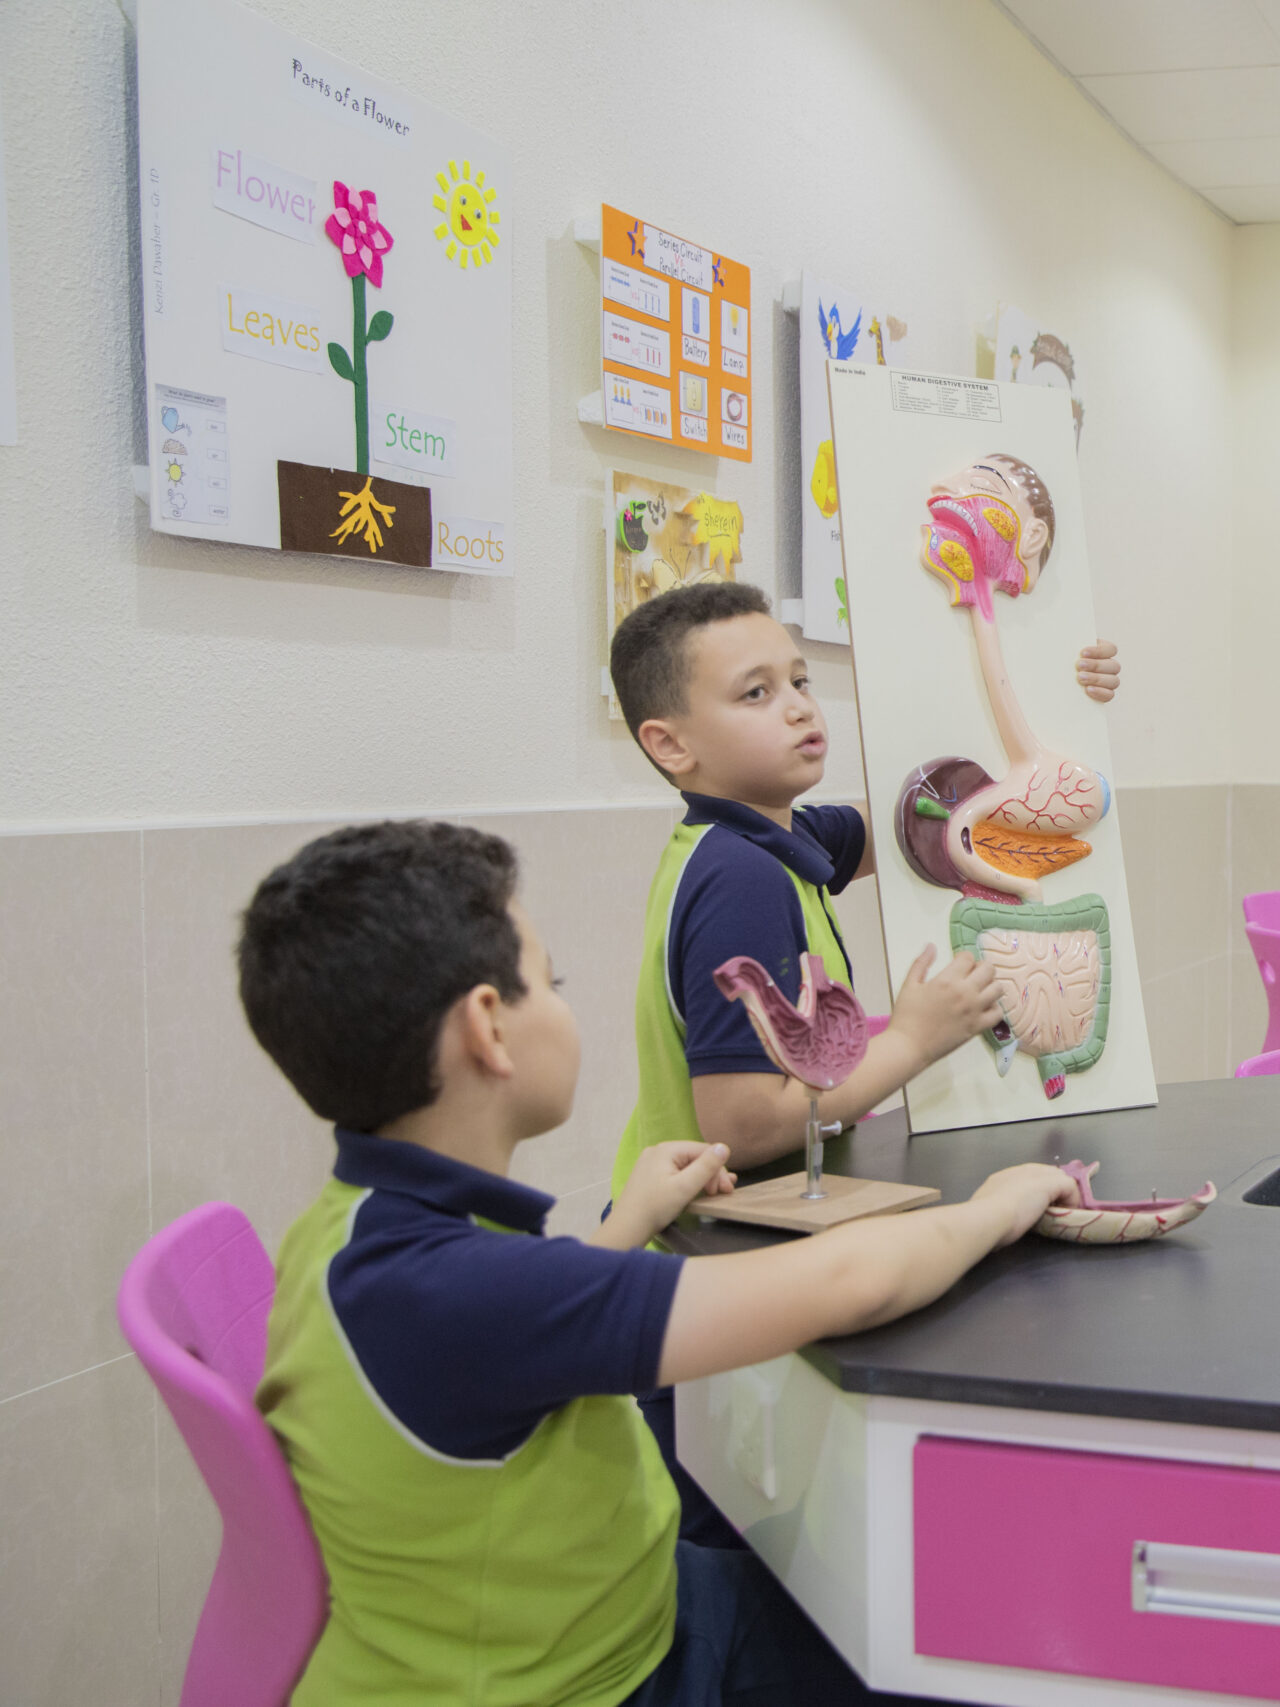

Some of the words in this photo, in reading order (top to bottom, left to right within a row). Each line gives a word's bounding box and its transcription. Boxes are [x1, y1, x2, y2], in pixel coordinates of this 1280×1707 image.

[292, 58, 331, 97] Parts
[335, 87, 351, 106] of
[351, 99, 360, 112] a
[364, 97, 410, 136] Flower
[216, 149, 317, 225] Flower
[658, 232, 680, 254] Series
[680, 242, 703, 264] Circuit
[681, 268, 703, 286] Circuit
[227, 293, 321, 353] Leaves
[684, 337, 707, 363] Battery
[901, 375, 926, 383] HUMAN
[927, 379, 962, 388] DIGESTIVE
[963, 383, 989, 391] SYSTEM
[386, 412, 446, 461] Stem
[684, 416, 707, 436] Switch
[725, 424, 745, 445] Wires
[438, 521, 505, 563] Roots
